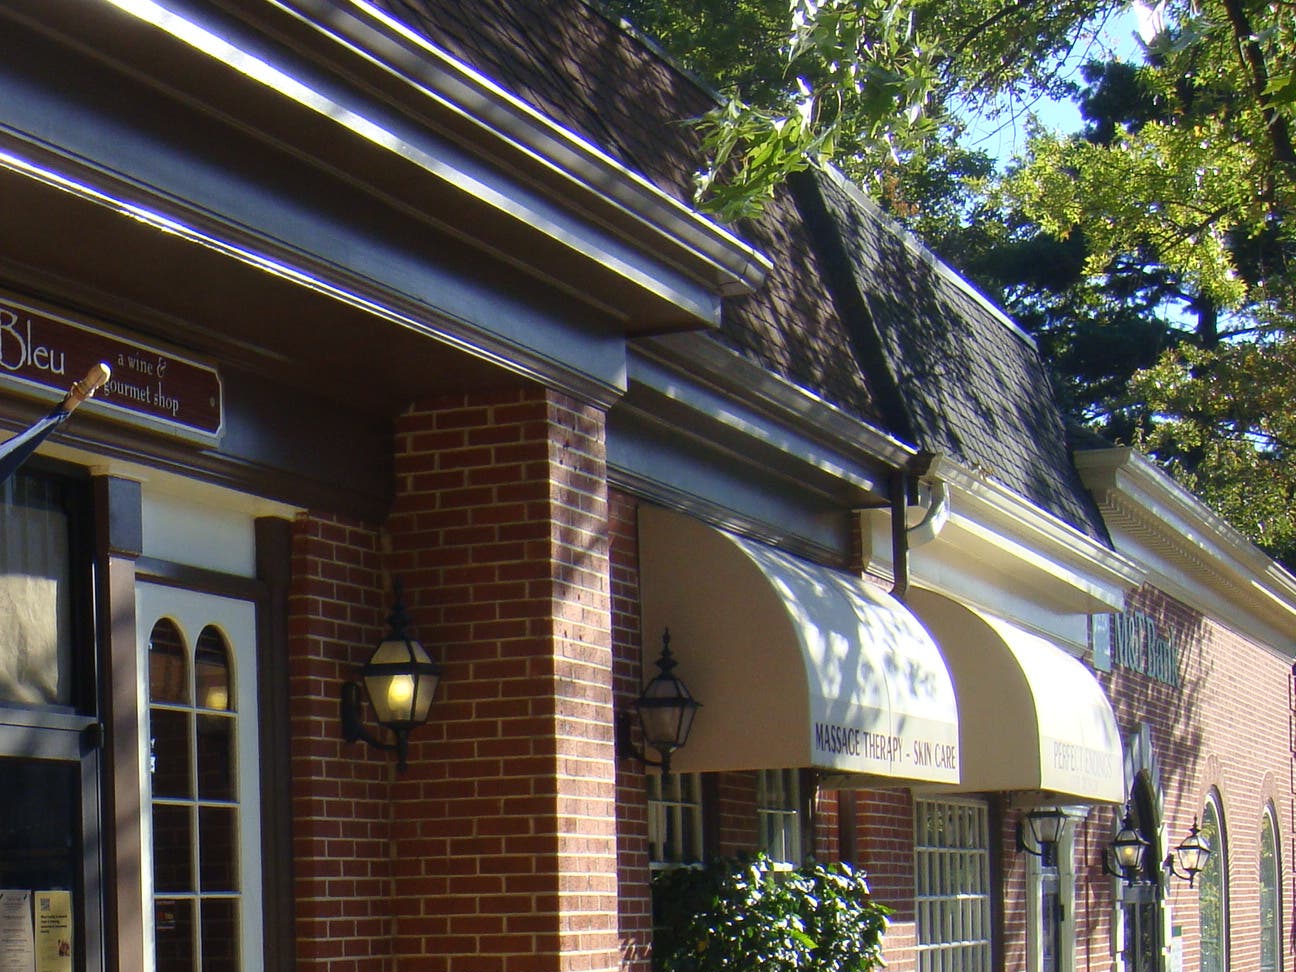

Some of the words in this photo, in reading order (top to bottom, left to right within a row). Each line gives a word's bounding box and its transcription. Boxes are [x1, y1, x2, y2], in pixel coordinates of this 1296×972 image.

[118, 353, 124, 366] a
[127, 351, 153, 376] wine
[157, 356, 167, 378] &
[104, 380, 151, 404] gourmet
[153, 381, 179, 417] shop
[1145, 616, 1179, 689] Bank
[815, 722, 860, 756] MASSAGE
[864, 731, 903, 763] THERAPY
[913, 740, 933, 766] SKIN
[935, 743, 956, 769] CARE
